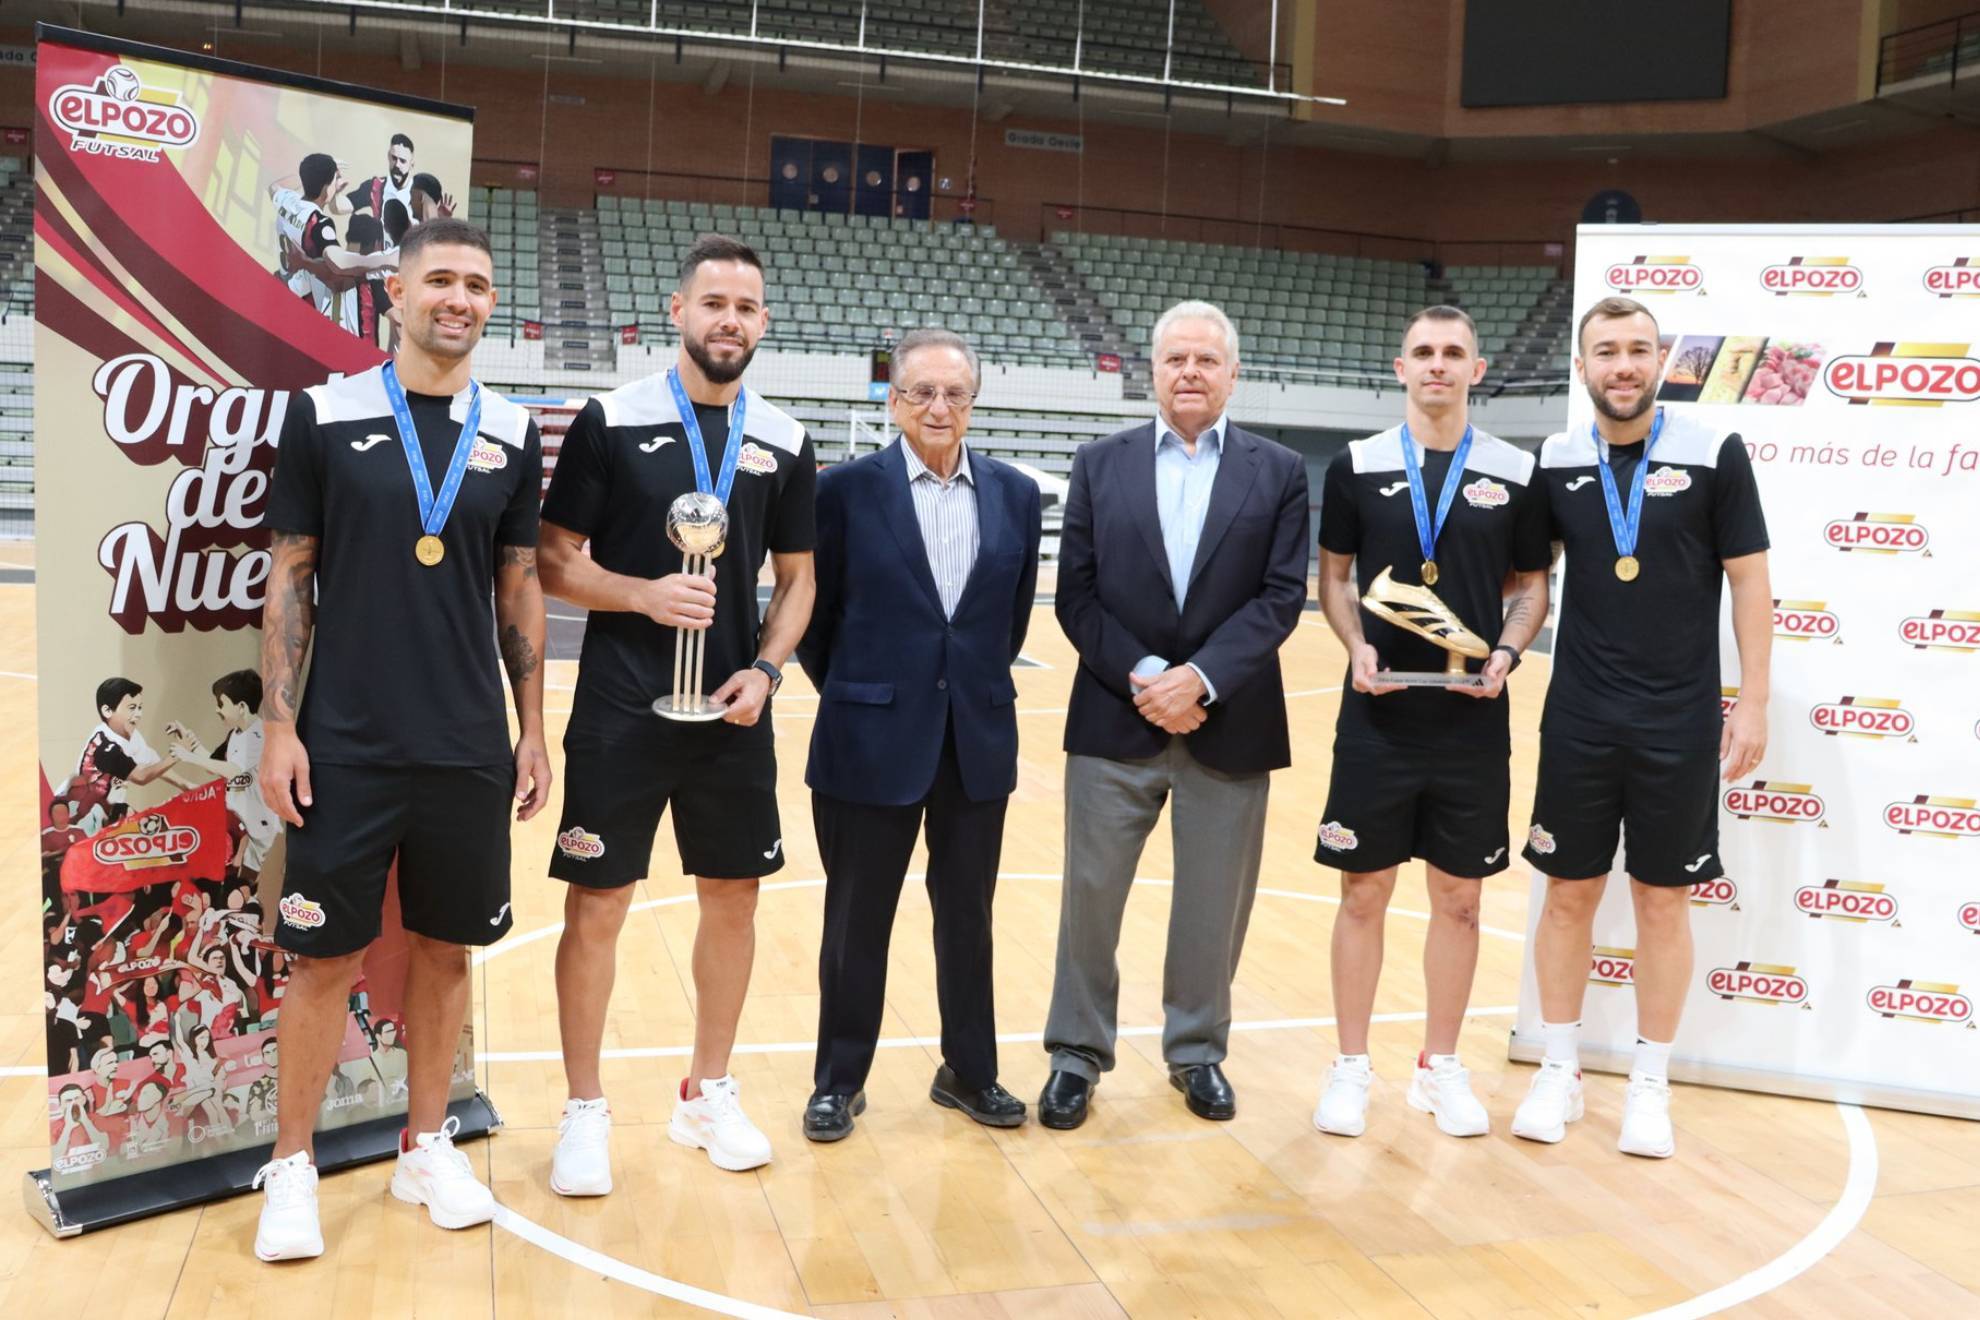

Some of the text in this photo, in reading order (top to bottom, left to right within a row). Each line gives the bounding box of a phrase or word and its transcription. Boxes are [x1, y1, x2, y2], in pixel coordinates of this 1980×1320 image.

[71, 139, 160, 162] FUTSAL
[1790, 442, 1850, 466] más
[1862, 444, 1897, 467] de
[1908, 446, 1934, 468] la
